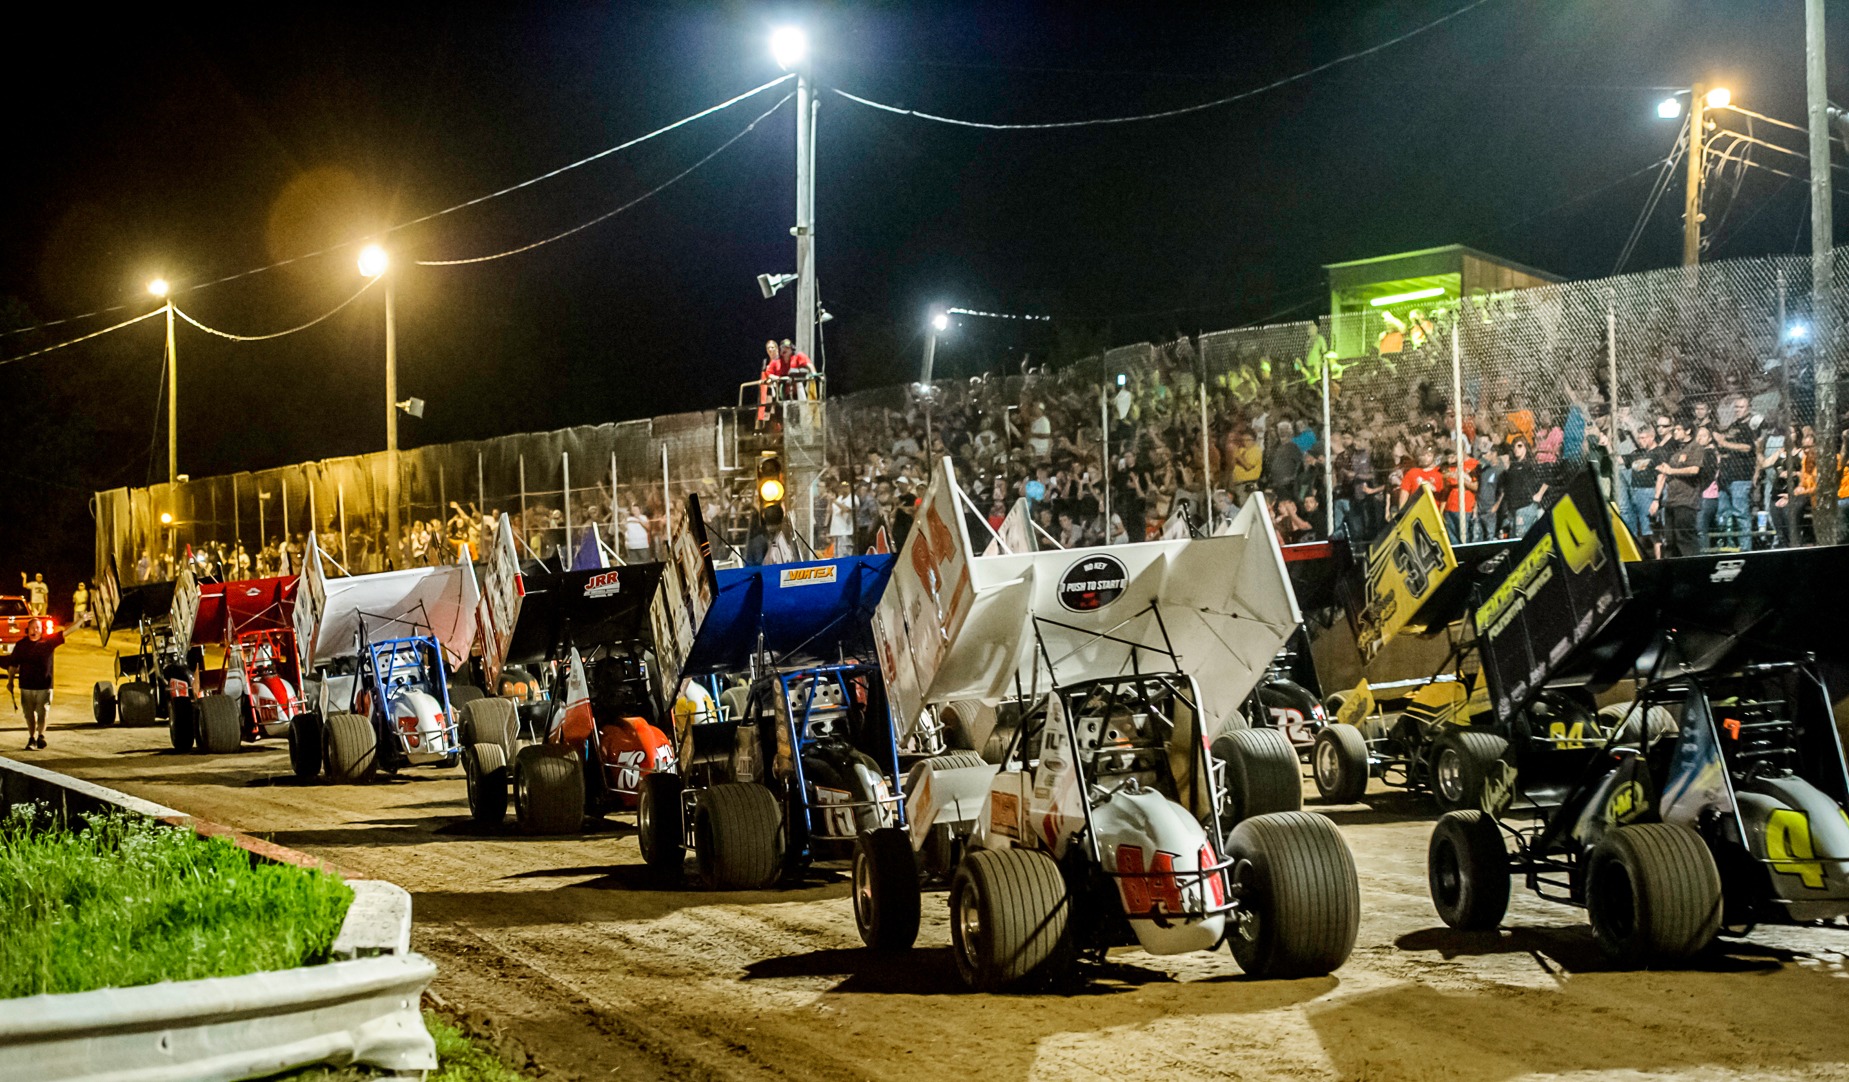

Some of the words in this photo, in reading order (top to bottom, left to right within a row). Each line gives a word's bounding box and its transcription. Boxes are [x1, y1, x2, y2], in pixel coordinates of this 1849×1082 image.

[1552, 493, 1607, 574] 4
[1083, 563, 1093, 572] NO
[1094, 562, 1108, 570] KEY
[1392, 517, 1446, 599] 34
[584, 571, 619, 590] JRR
[788, 566, 835, 580] VORTEX
[1066, 582, 1086, 592] PUSH
[1087, 581, 1096, 590] TO
[1097, 580, 1120, 590] START
[617, 750, 645, 789] 76
[1766, 808, 1828, 890] 4
